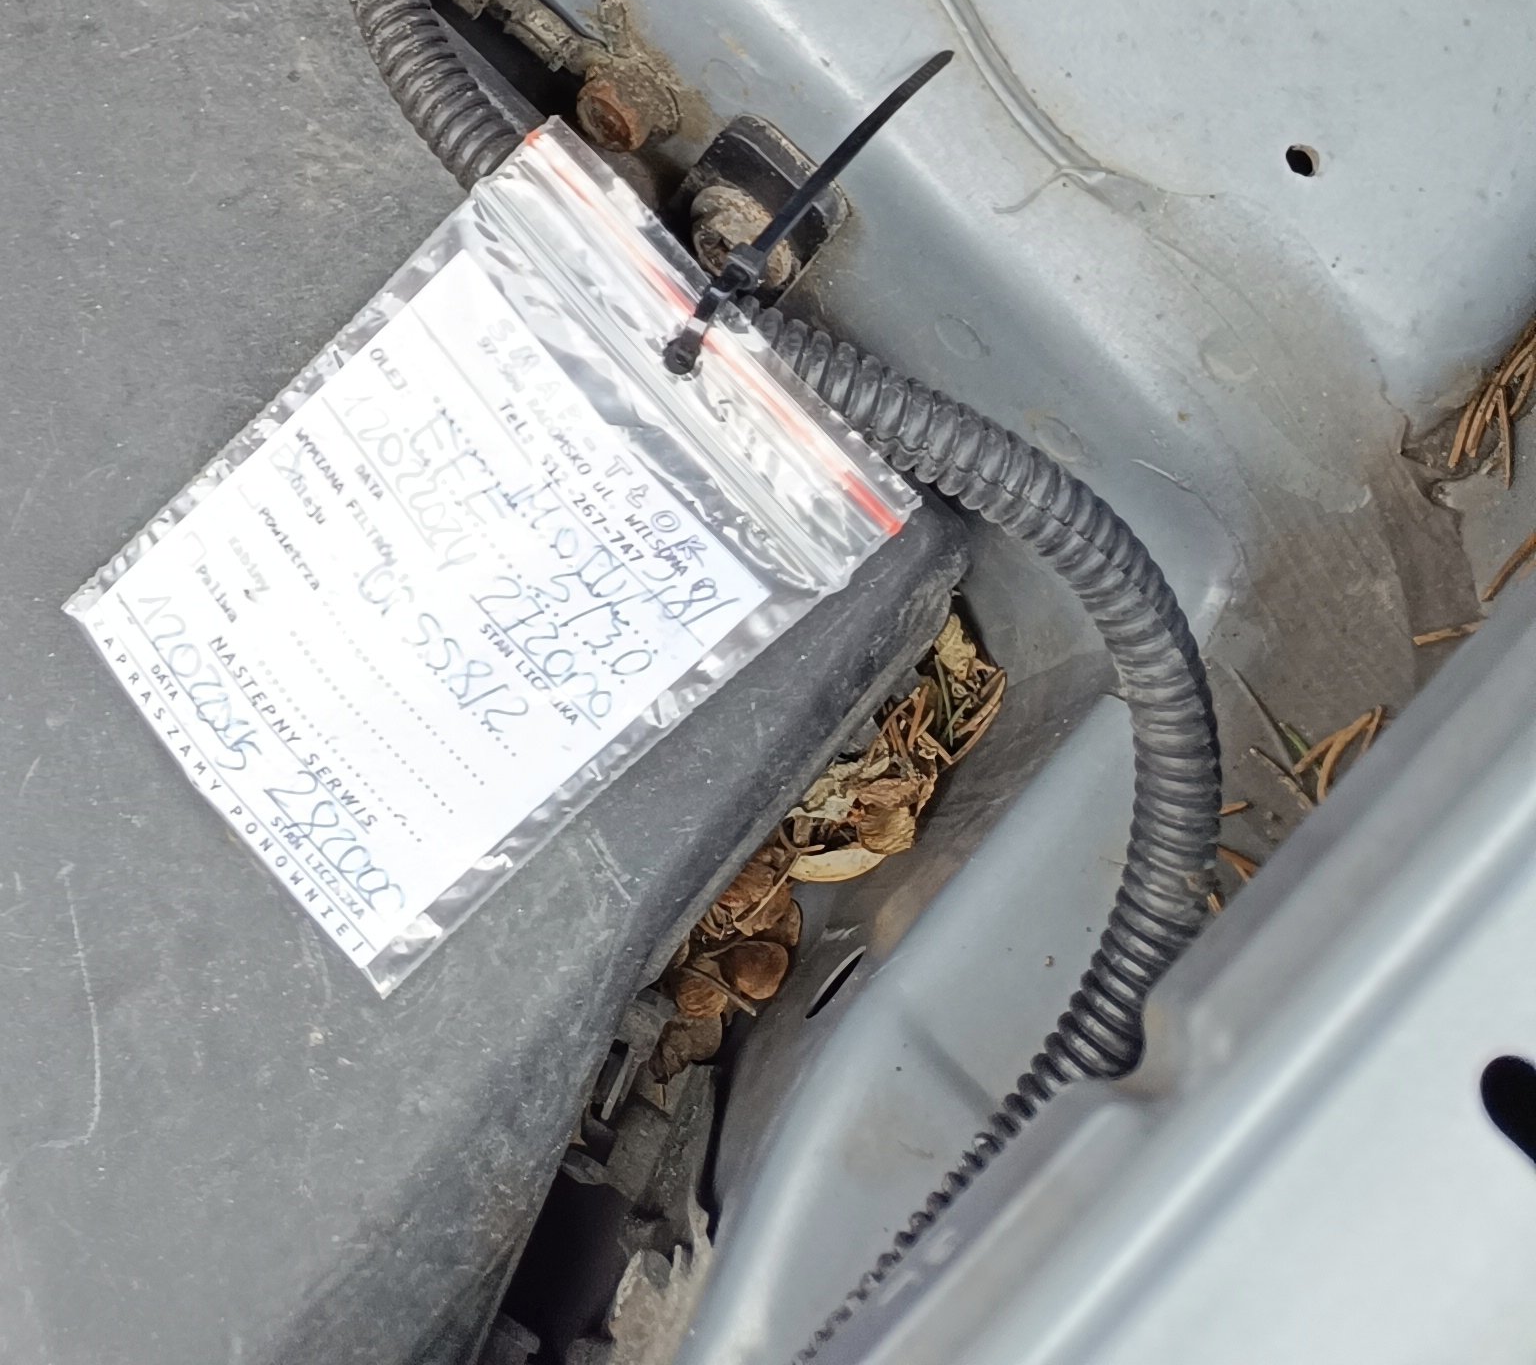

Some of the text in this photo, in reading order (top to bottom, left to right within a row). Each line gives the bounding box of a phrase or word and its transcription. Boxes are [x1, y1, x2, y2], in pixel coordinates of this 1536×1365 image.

[292, 426, 347, 496] WYMIANA
[524, 395, 594, 478] RADOMSKO
[352, 462, 386, 502] DATA
[537, 451, 645, 566] 512-267-747
[256, 505, 324, 592] Powietrza
[193, 562, 241, 625] Paliwa
[479, 621, 515, 658] STAN
[148, 662, 181, 701] DATA
[207, 633, 379, 829] NASTĘPNY SERWIS
[269, 814, 305, 850] STAN
